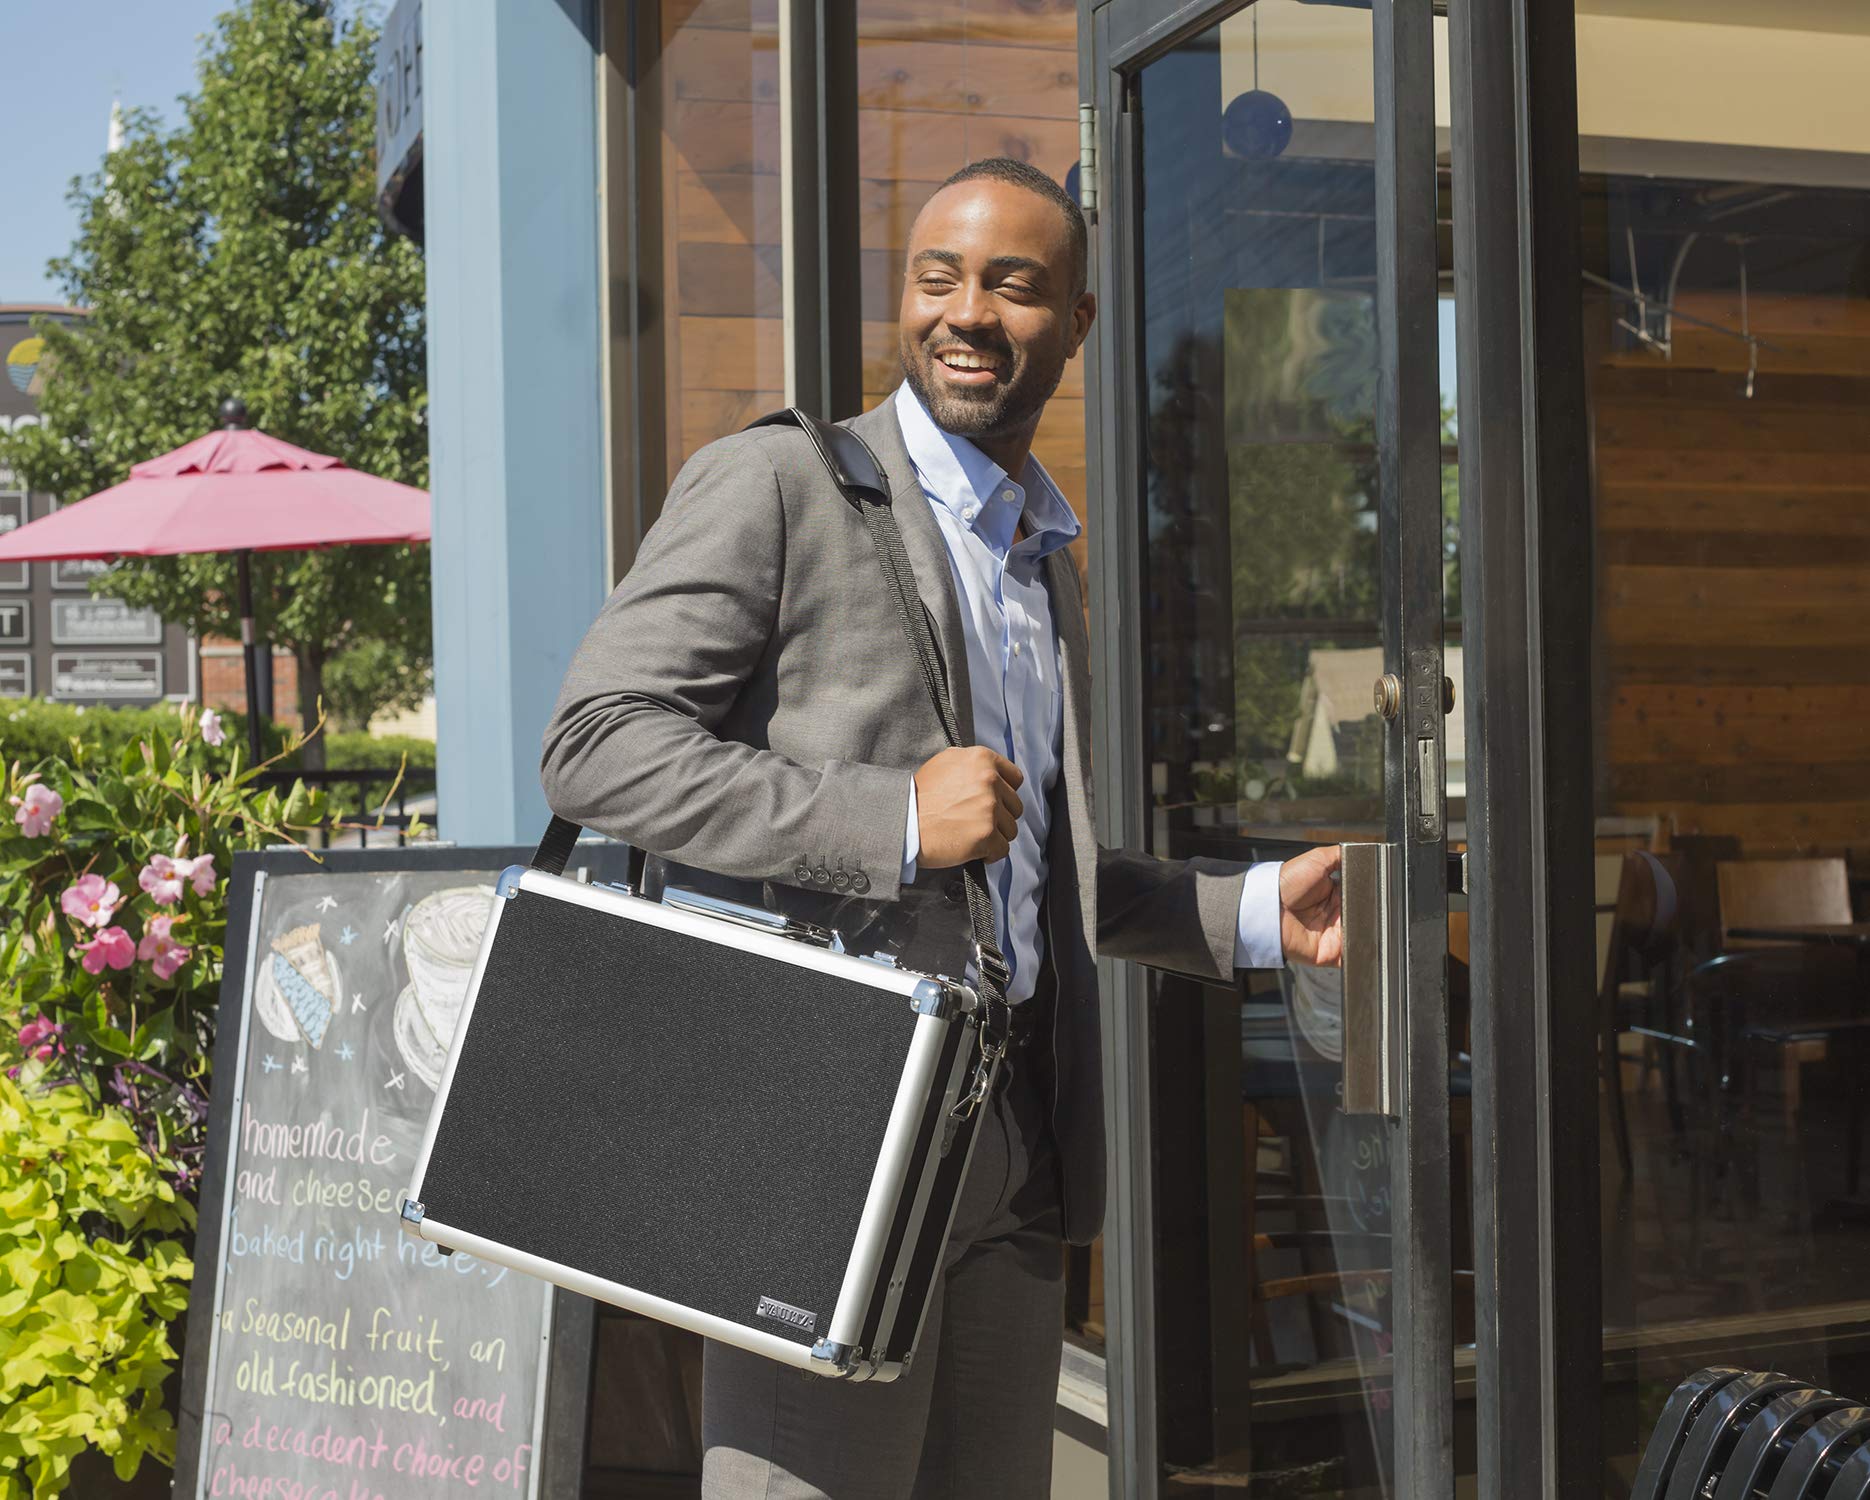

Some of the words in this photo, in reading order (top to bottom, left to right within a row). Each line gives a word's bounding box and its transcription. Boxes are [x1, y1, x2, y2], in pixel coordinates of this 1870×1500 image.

[243, 1102, 396, 1165] homemade
[237, 1167, 280, 1205] and
[314, 1229, 385, 1280] right
[220, 1309, 233, 1334] a
[366, 1306, 450, 1372] fruit,
[469, 1337, 506, 1372] an
[236, 1350, 278, 1396] old
[280, 1356, 447, 1427] fashioned,
[452, 1392, 507, 1433] and
[215, 1422, 232, 1446] a
[242, 1414, 389, 1471] decadent
[392, 1436, 485, 1487] choice
[491, 1443, 533, 1490] of
